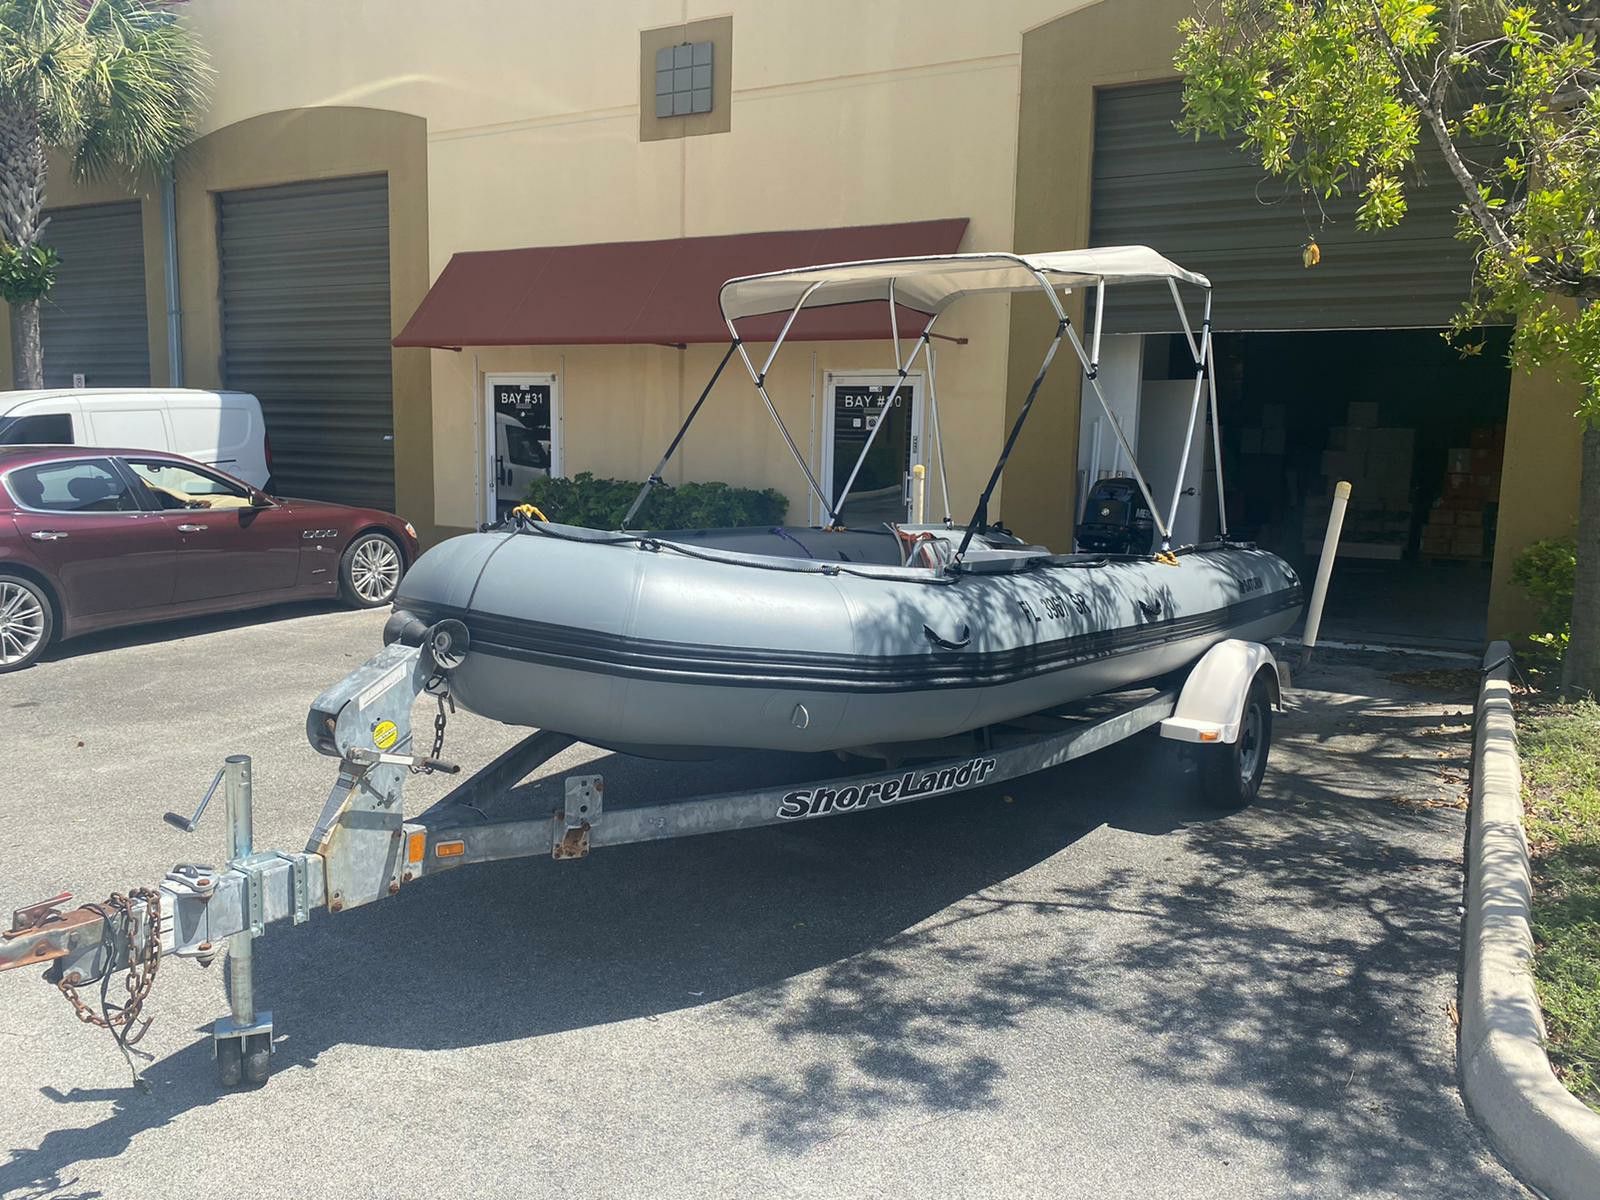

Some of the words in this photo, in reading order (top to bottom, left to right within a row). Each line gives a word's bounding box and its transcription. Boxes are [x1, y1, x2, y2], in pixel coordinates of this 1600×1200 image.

[501, 393, 522, 404] BAY
[524, 392, 543, 404] #31
[845, 395, 872, 408] BAY
[1016, 600, 1041, 623] FL
[1040, 595, 1069, 619] 3967
[1069, 592, 1092, 615] SR
[776, 757, 997, 819] ShoreLand'r
